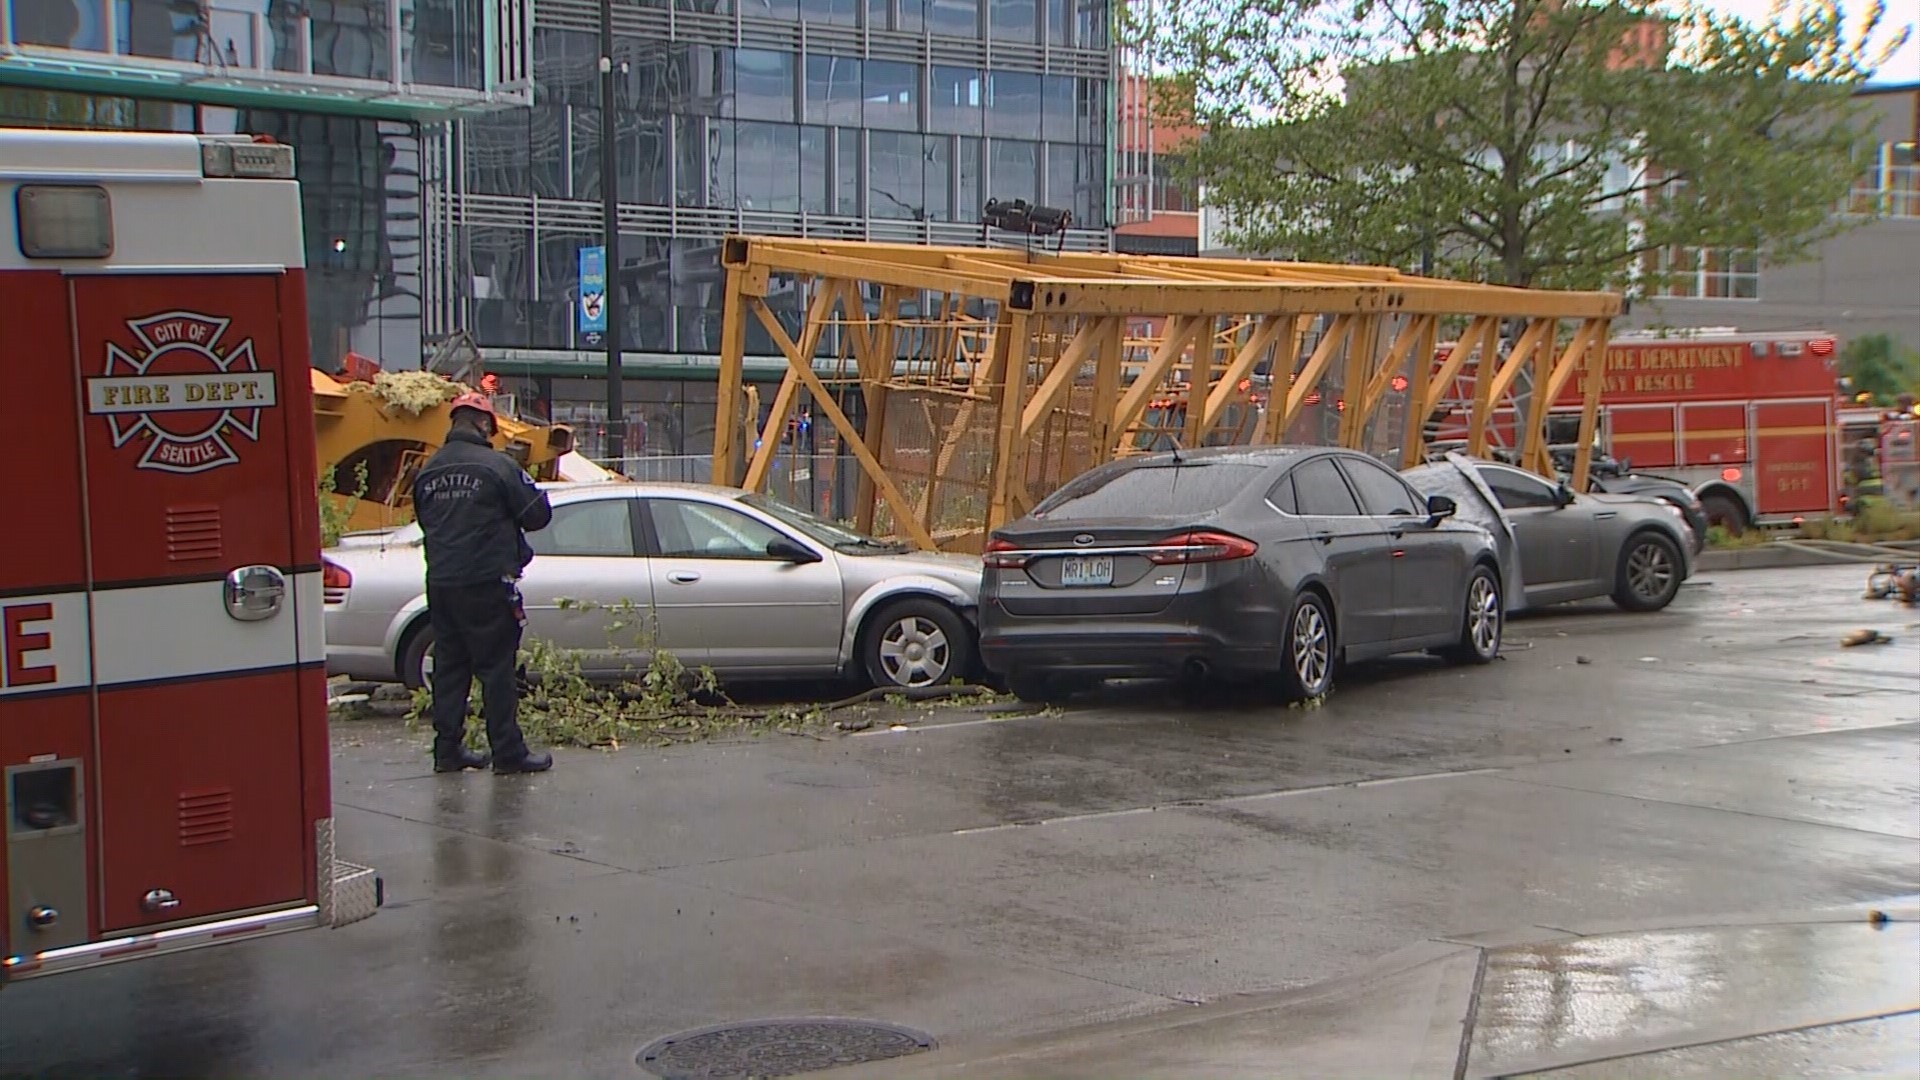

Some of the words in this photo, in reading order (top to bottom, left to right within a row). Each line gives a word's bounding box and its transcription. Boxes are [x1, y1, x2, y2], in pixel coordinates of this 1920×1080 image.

[154, 321, 185, 343] CITY
[189, 323, 207, 343] OF
[1607, 348, 1636, 371] IRE
[1640, 346, 1743, 369] DEPARTMENT
[103, 384, 170, 406] FIRE
[184, 380, 264, 403] DEPT.
[1634, 373, 1695, 391] RESCUE
[160, 441, 217, 464] SEATTLE
[424, 473, 483, 494] SEATTLE
